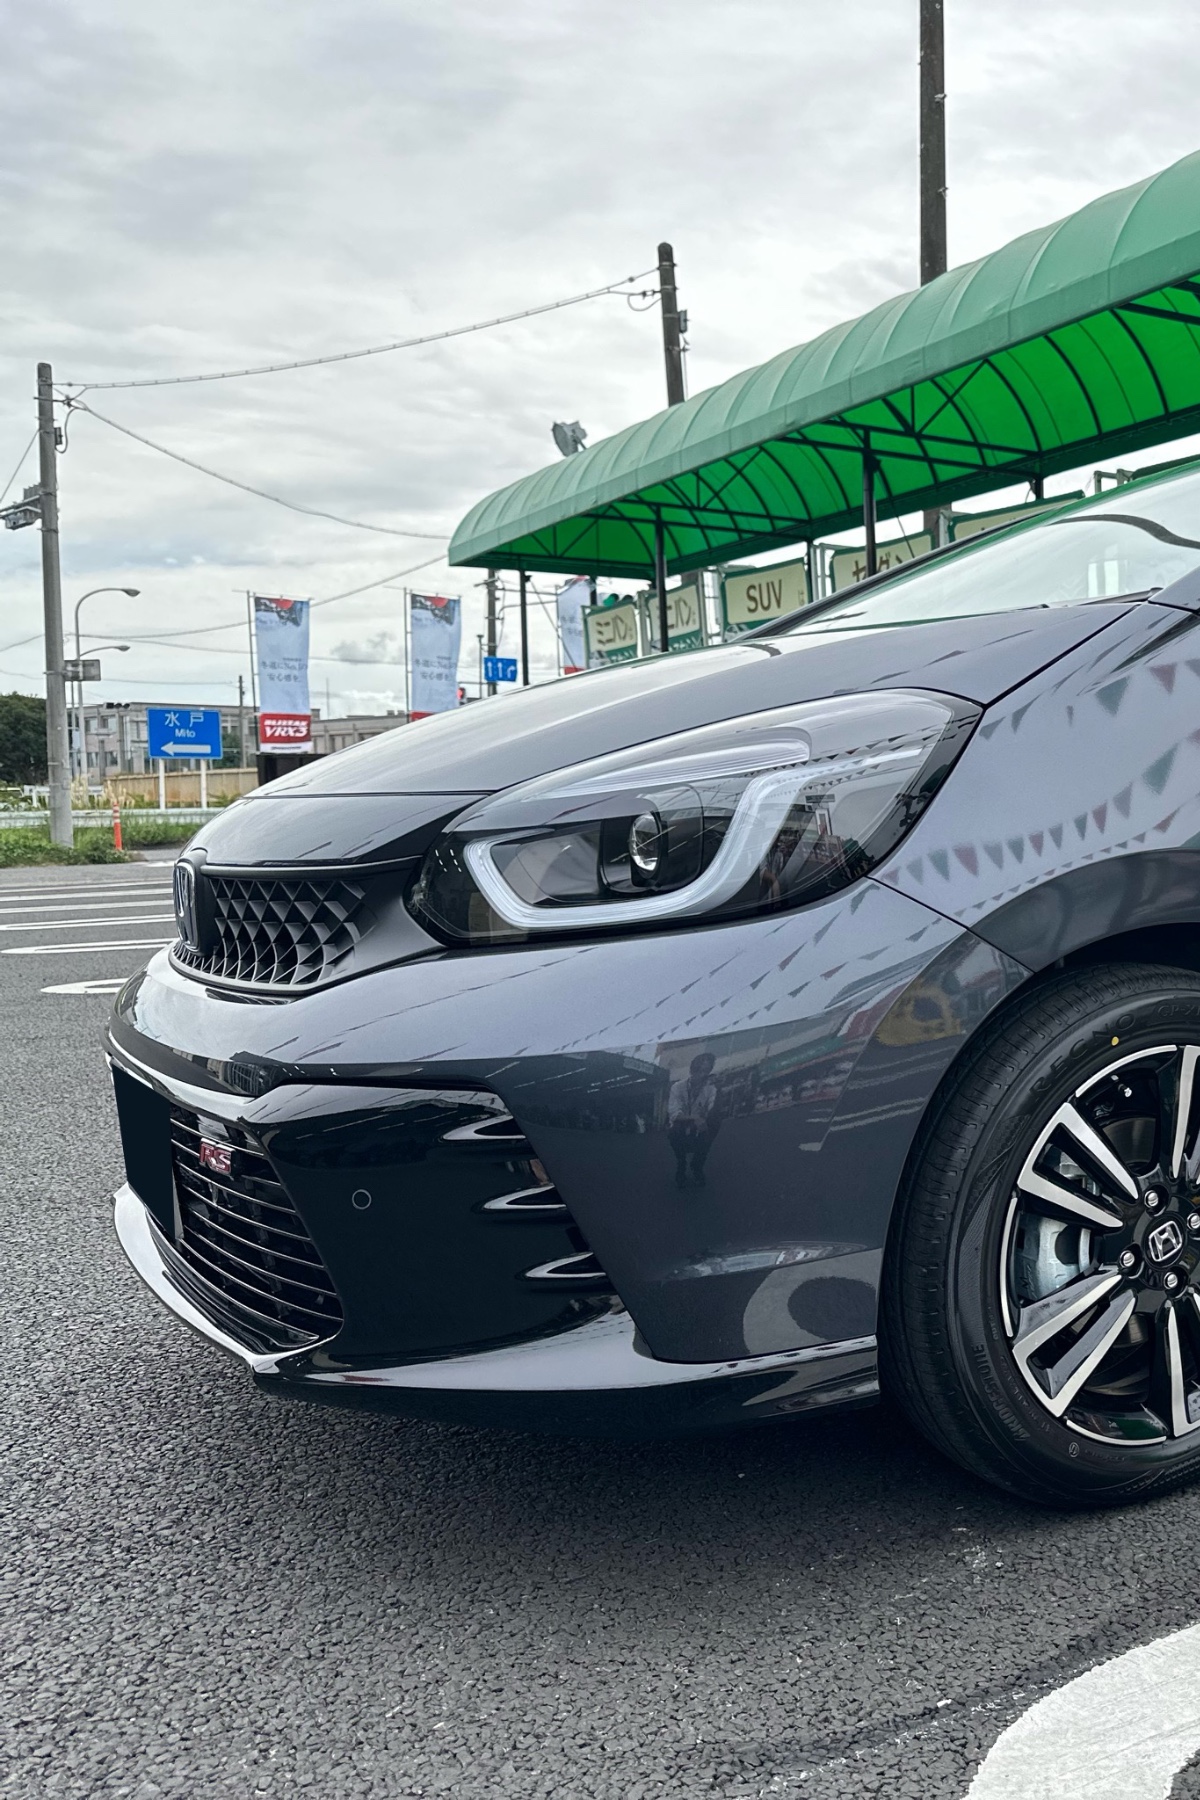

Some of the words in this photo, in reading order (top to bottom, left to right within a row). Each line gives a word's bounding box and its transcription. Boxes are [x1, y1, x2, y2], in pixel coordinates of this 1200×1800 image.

[164, 711, 204, 727] 水戸
[175, 728, 196, 738] Mito
[264, 726, 308, 738] VRX3
